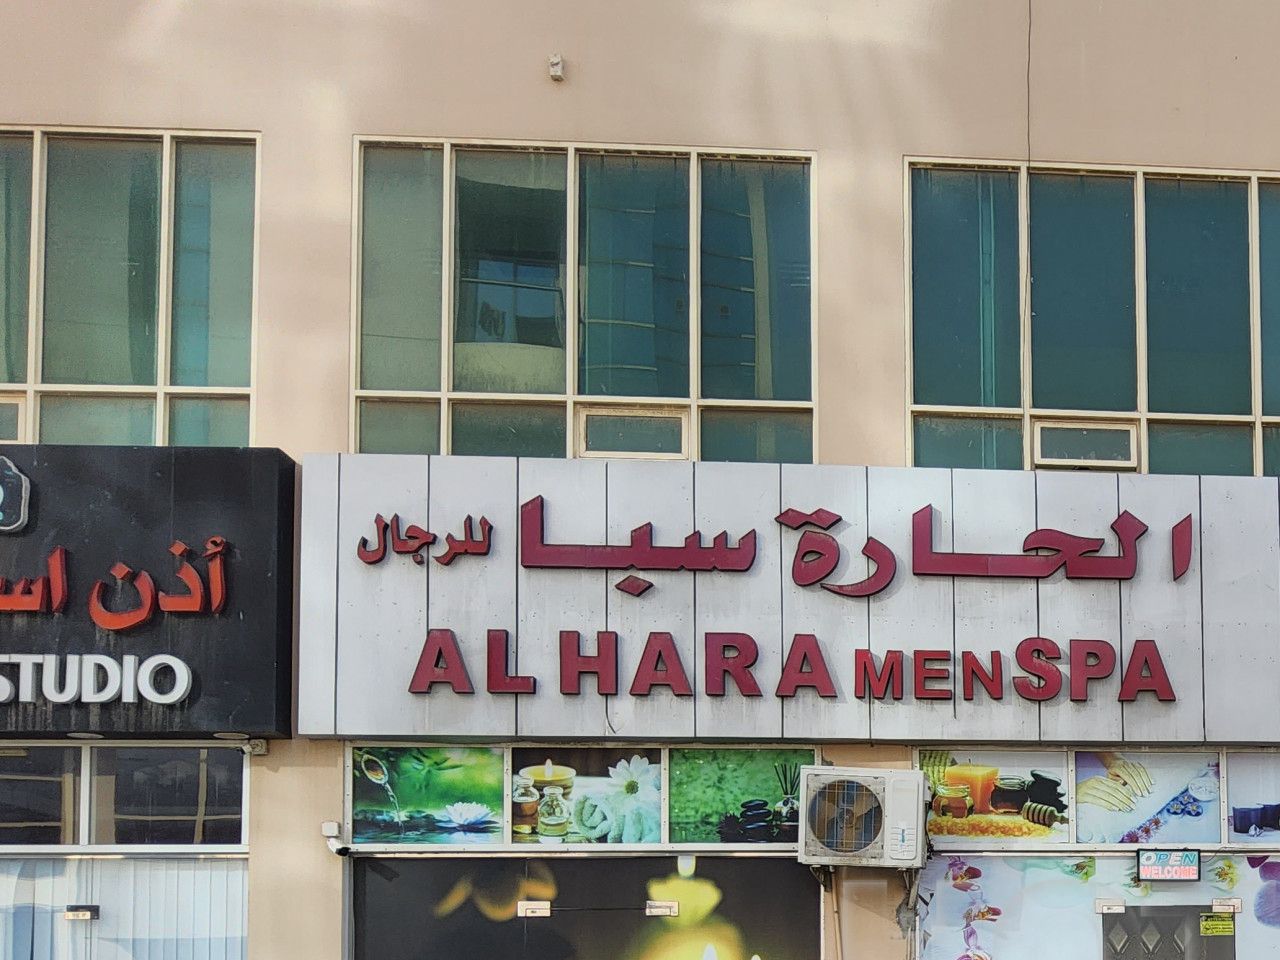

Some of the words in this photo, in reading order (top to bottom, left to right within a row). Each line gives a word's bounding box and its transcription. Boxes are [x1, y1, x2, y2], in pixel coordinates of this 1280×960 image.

[357, 513, 494, 566] للرجال
[775, 503, 1193, 598] الحارة
[408, 628, 537, 695] AL
[559, 630, 838, 698] HARA
[1140, 866, 1198, 879] WELCOME
[1141, 852, 1196, 865] OPEN
